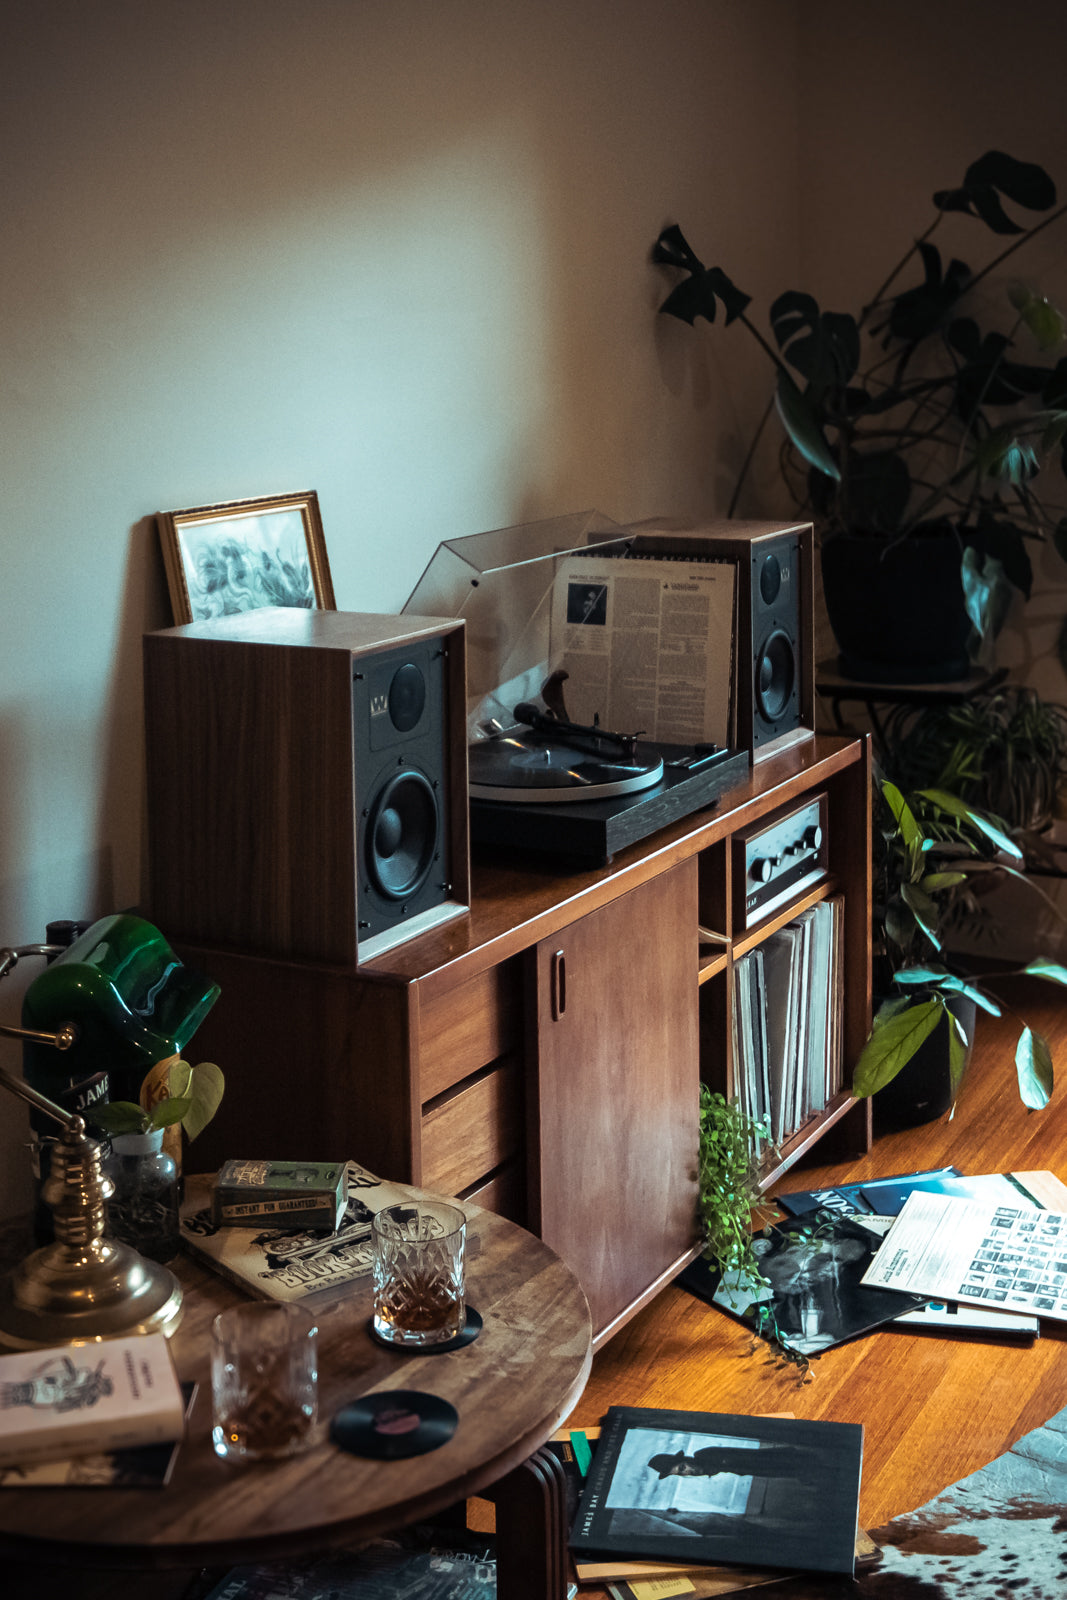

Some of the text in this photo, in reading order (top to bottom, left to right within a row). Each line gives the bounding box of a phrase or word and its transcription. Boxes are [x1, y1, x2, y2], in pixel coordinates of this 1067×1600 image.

[264, 1203, 275, 1213] FUN
[581, 1512, 594, 1536] JAMES
[589, 1495, 599, 1508] BAY
